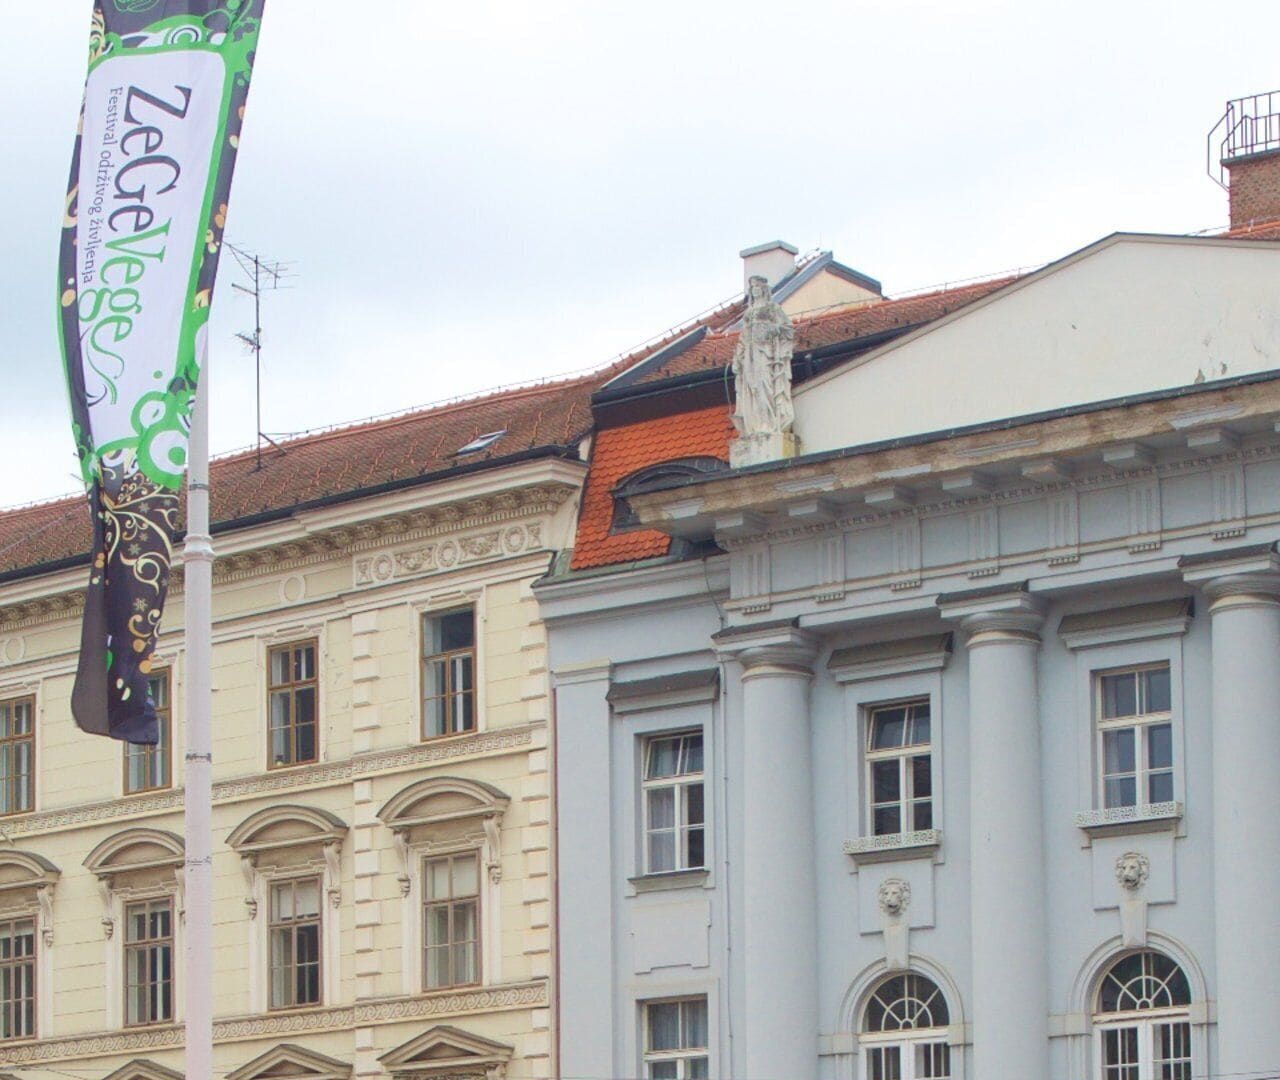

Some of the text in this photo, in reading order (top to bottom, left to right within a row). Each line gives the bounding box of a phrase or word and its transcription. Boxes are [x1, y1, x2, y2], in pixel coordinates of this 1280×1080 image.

[79, 85, 192, 352] ZeGeVege
[83, 86, 123, 283] Festival održivog življenja
